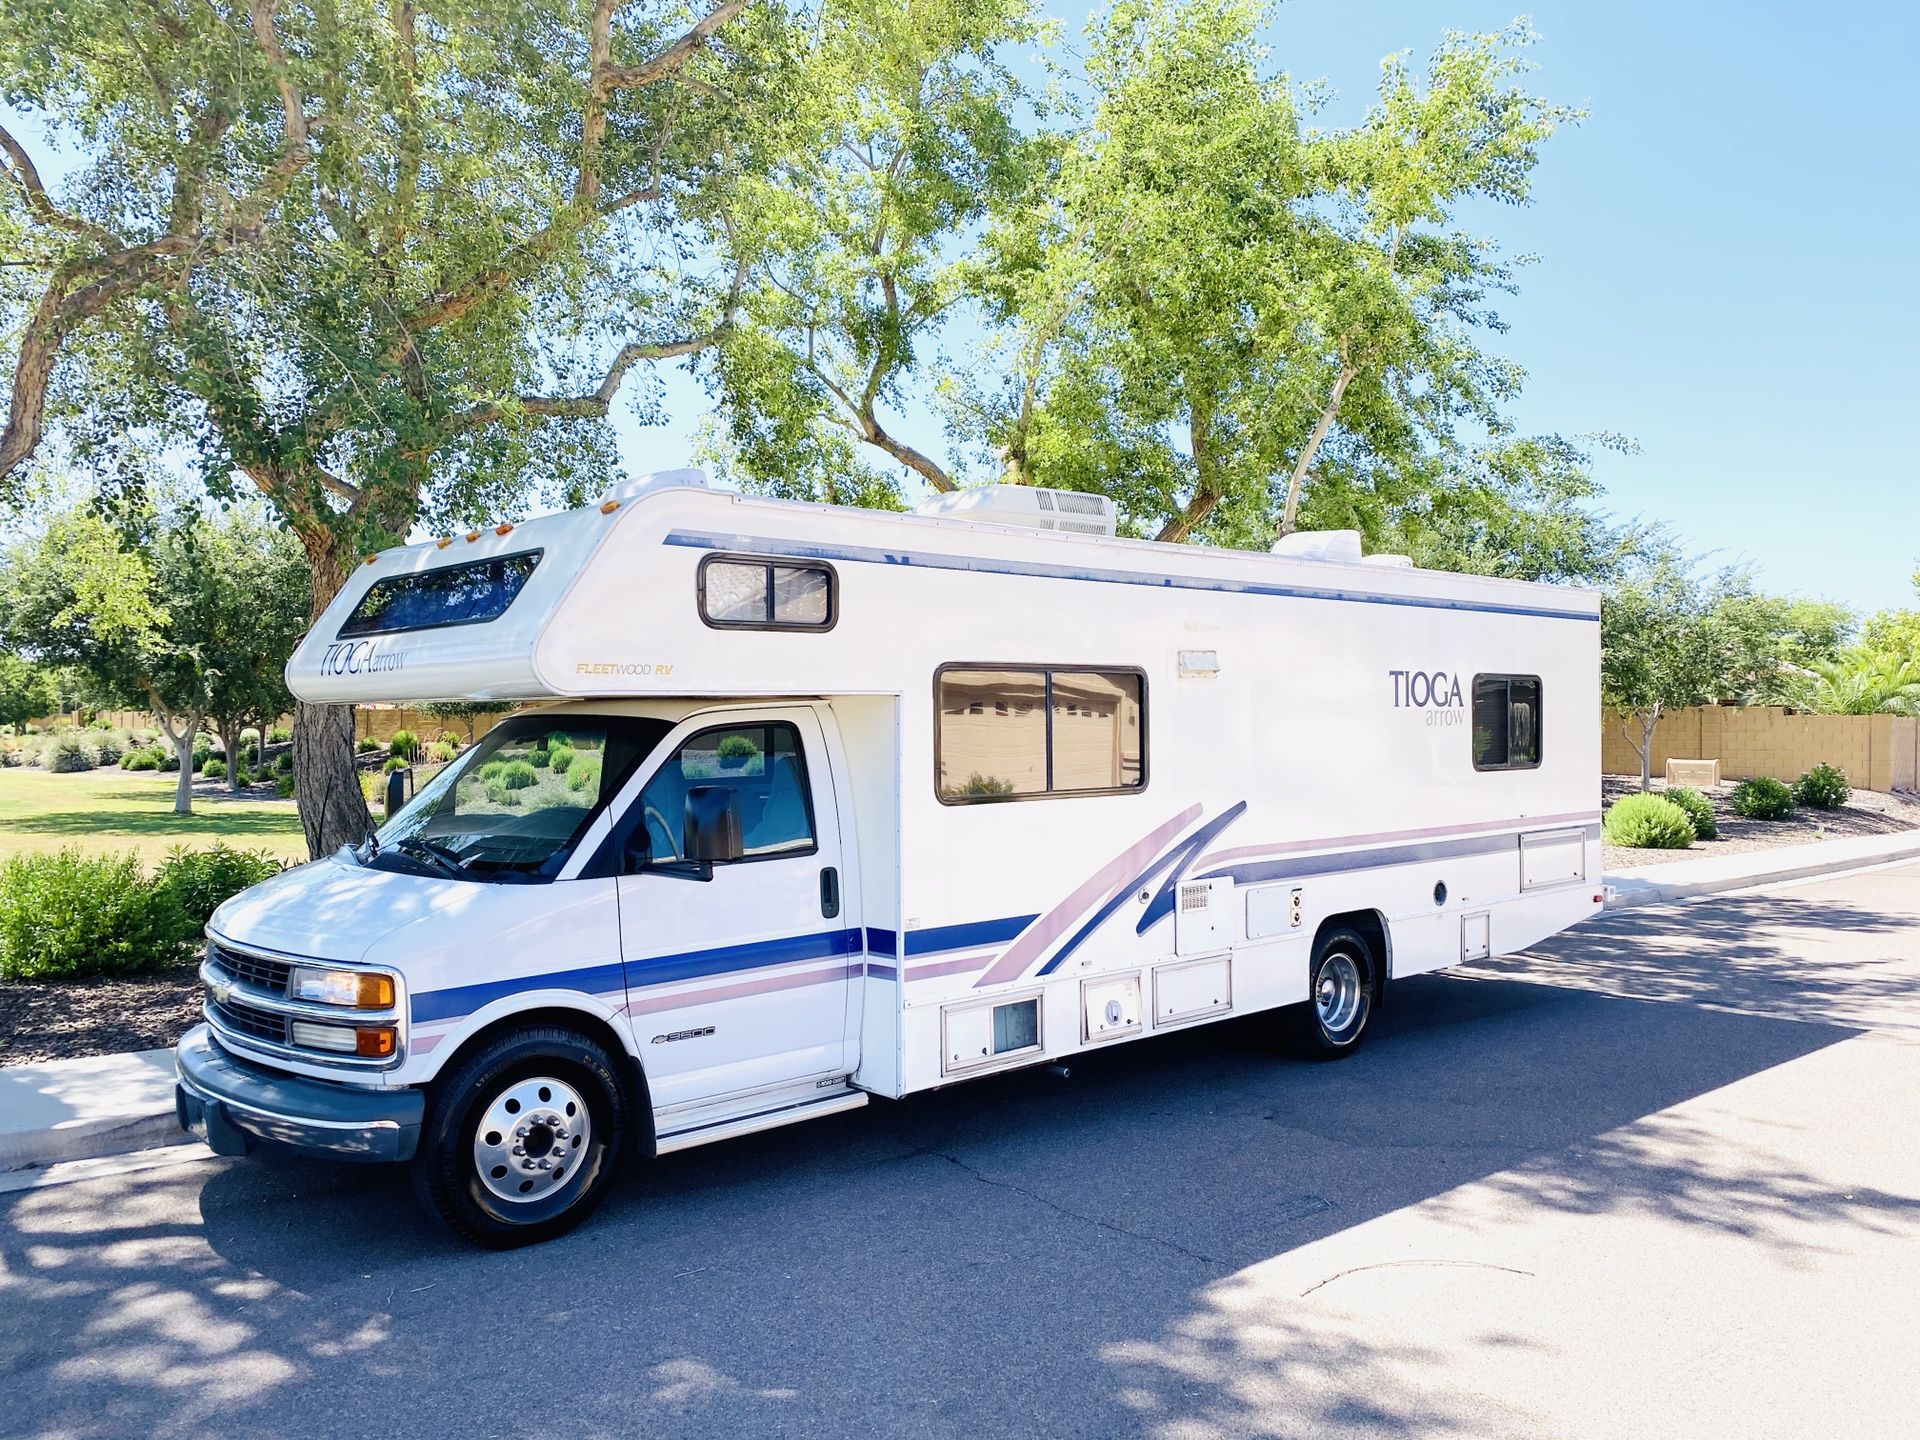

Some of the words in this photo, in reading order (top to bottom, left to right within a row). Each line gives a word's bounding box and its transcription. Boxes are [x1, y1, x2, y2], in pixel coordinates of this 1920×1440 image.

[320, 641, 377, 676] TIOGA
[372, 651, 408, 672] arrow
[576, 663, 651, 675] FLEETWOOD
[655, 664, 673, 675] RV
[1388, 670, 1464, 707] TIOGA
[1426, 708, 1465, 726] arrow
[667, 1026, 716, 1042] 3500
